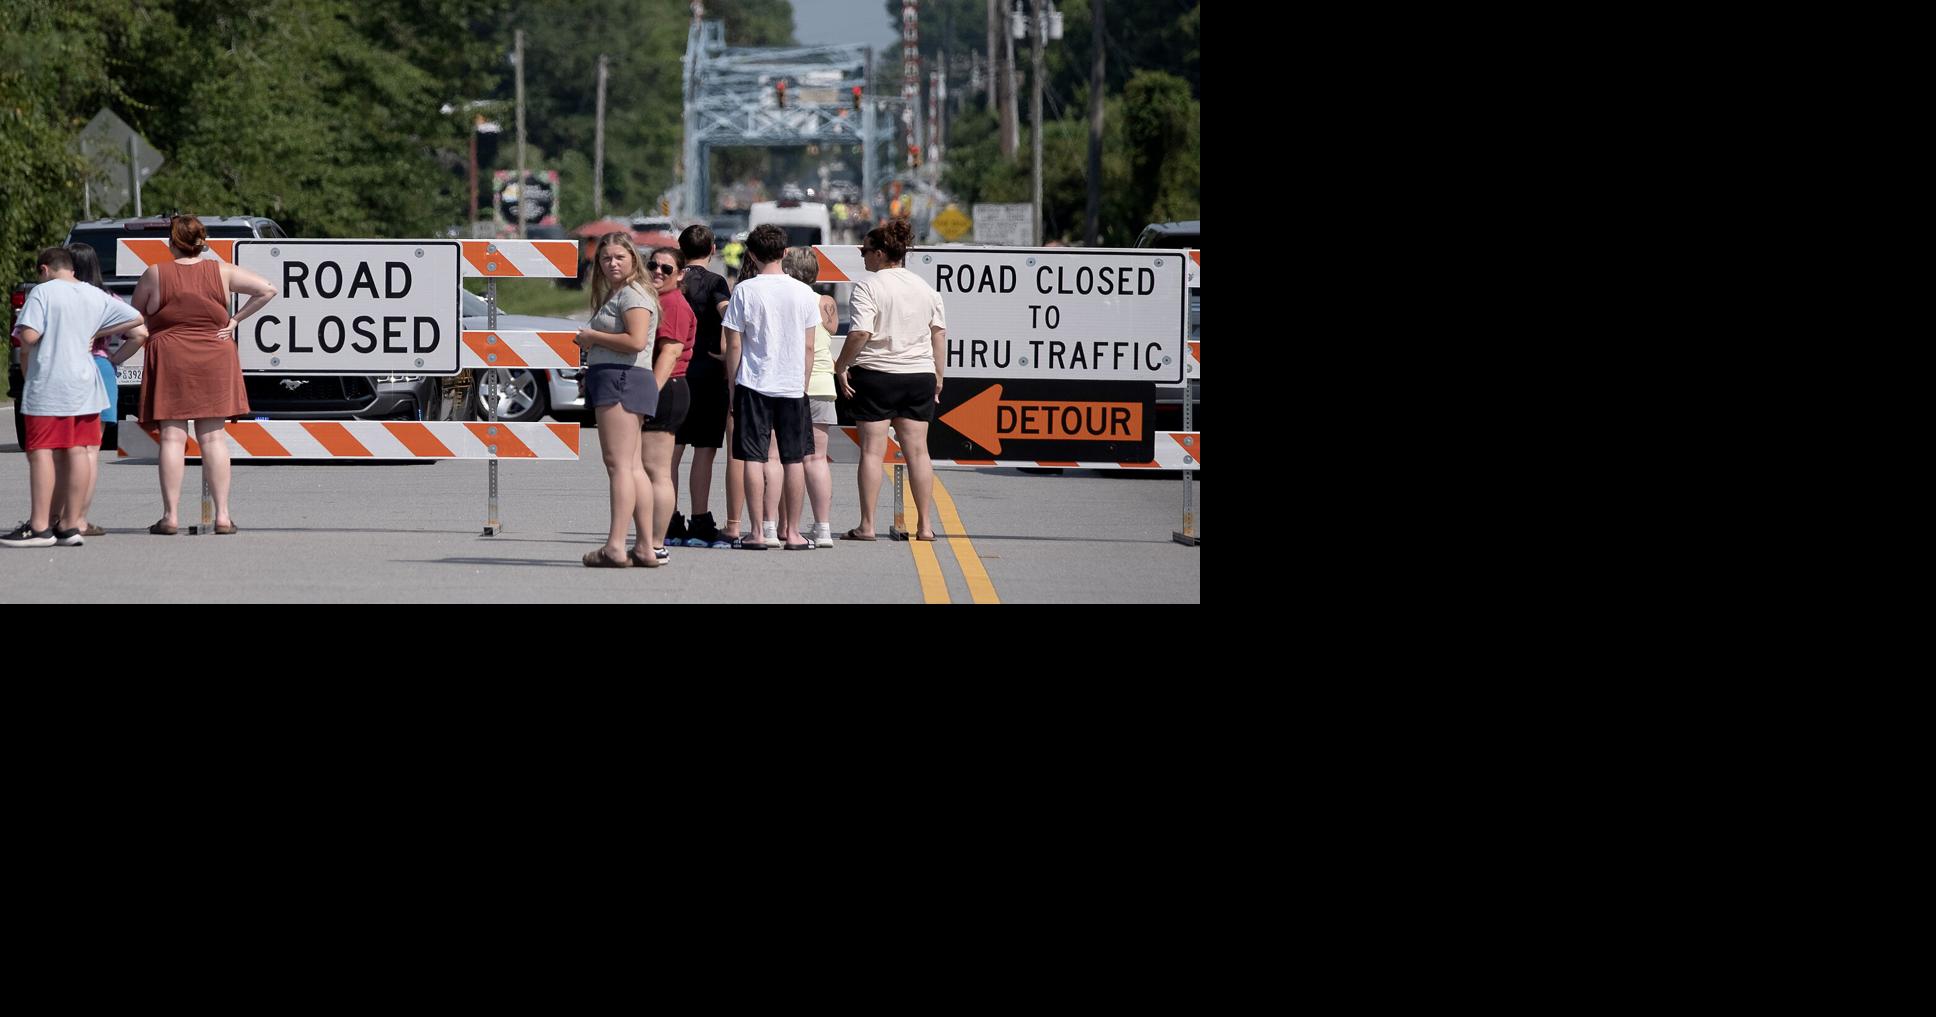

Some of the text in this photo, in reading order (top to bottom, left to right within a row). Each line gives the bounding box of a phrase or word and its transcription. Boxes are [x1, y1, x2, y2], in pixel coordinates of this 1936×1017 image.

[283, 260, 412, 299] ROAD
[935, 263, 1155, 296] ROAD CLOSED
[1028, 304, 1060, 330] TO
[254, 314, 441, 354] CLOSED
[946, 339, 1162, 371] HRU TRAFFIC
[996, 405, 1131, 436] DETOUR
